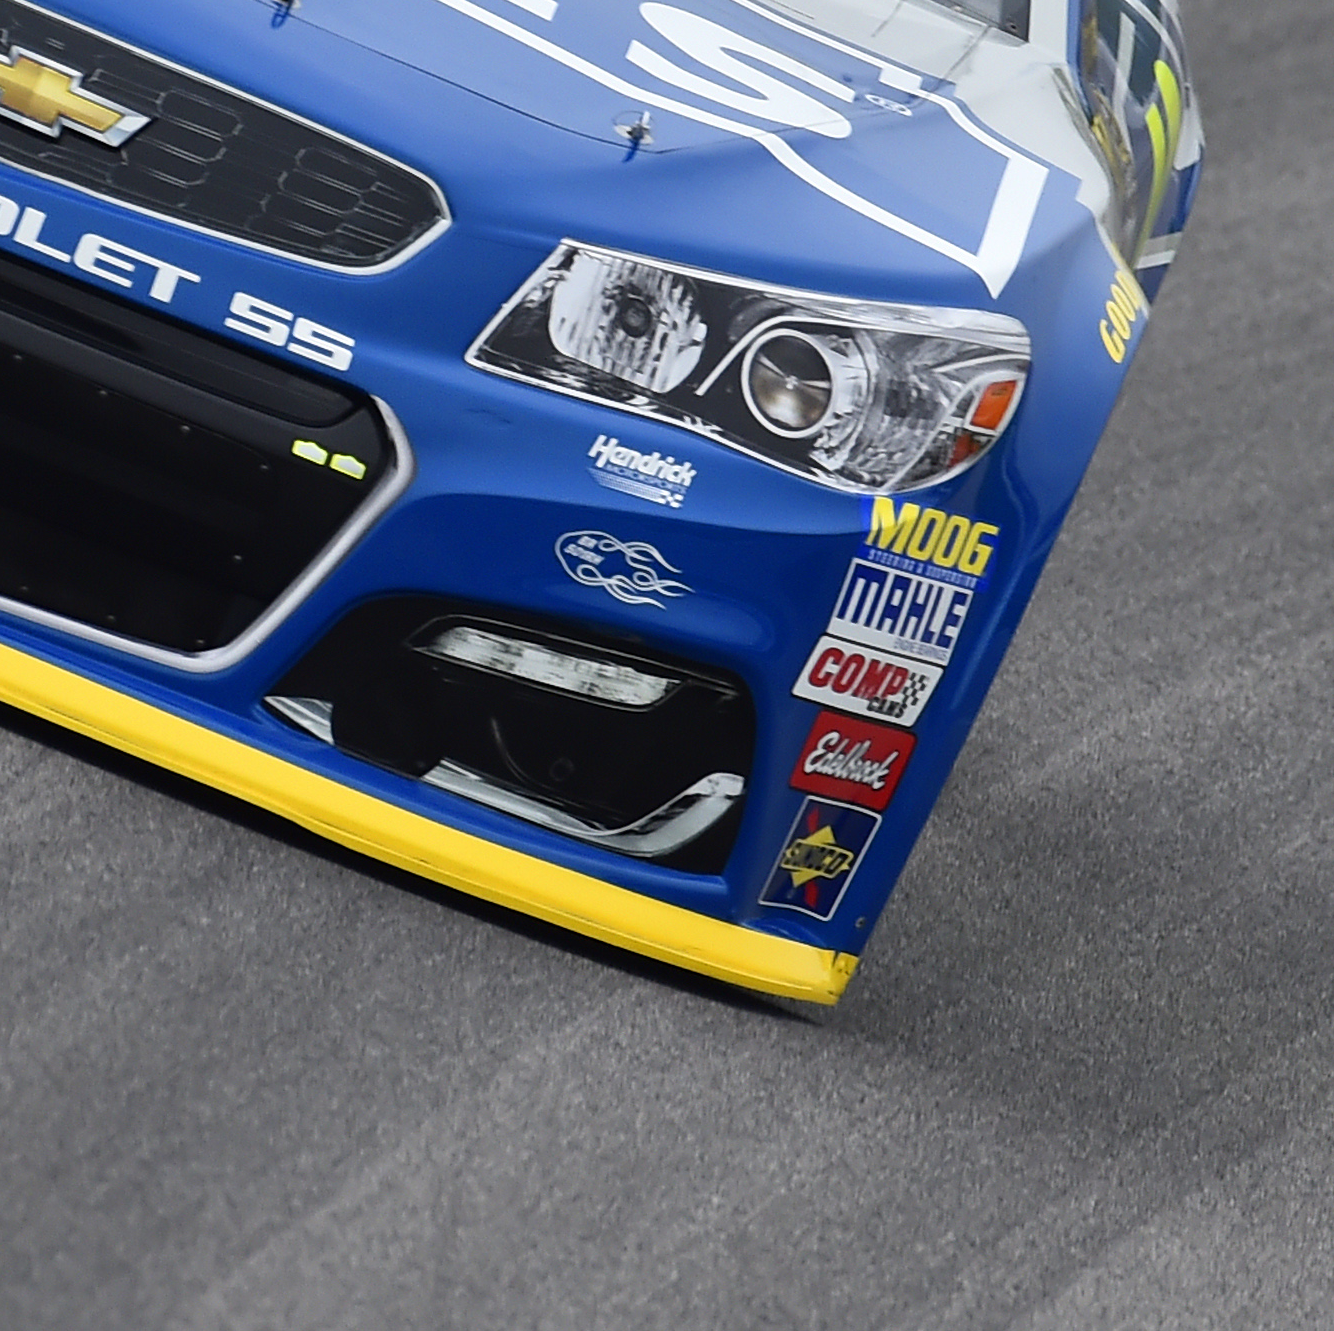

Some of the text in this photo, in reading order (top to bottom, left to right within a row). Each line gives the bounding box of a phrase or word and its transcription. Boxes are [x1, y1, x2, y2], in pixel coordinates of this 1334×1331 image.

[223, 291, 357, 372] SS
[587, 434, 698, 487] Hendrick
[864, 495, 1000, 577] MOOG
[835, 563, 970, 650] MAHLE
[807, 646, 910, 701] COMP
